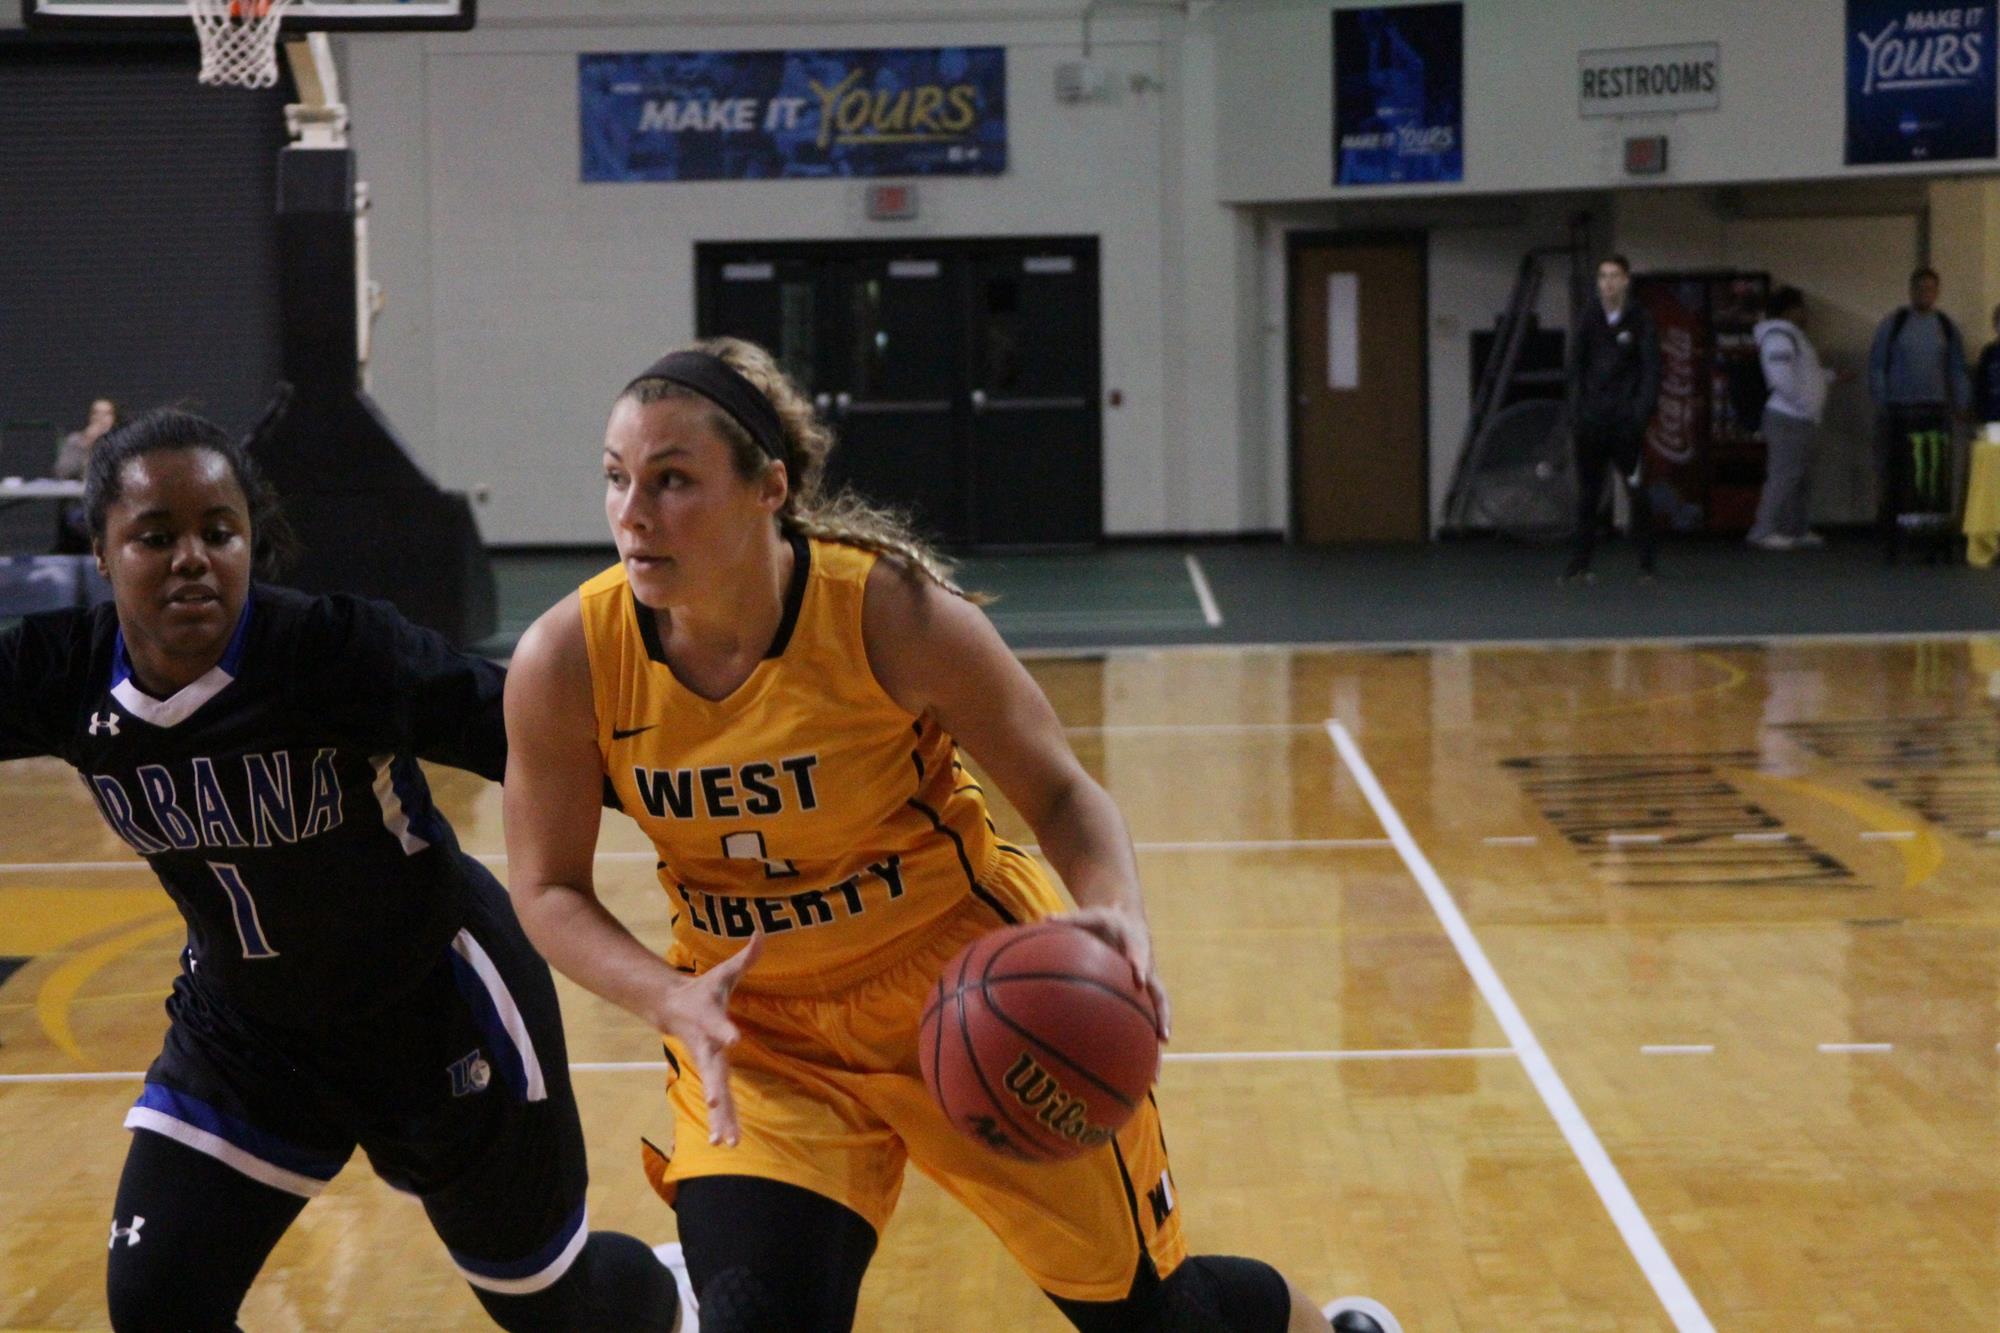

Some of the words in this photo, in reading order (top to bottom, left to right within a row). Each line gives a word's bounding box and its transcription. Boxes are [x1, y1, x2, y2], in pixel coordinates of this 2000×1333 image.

[1903, 9, 1962, 30] MAKE
[1965, 7, 1985, 28] IT
[1581, 60, 1716, 99] RESTROOMS
[1857, 20, 1982, 94] YOURS
[638, 98, 759, 133] MAKE
[764, 97, 807, 132] IT
[808, 67, 978, 149] YOURS
[1396, 119, 1455, 156] YOURS
[92, 747, 343, 854] RBANA
[633, 753, 819, 820] WEST
[205, 859, 280, 959] 1
[676, 853, 905, 939] LIBERTY
